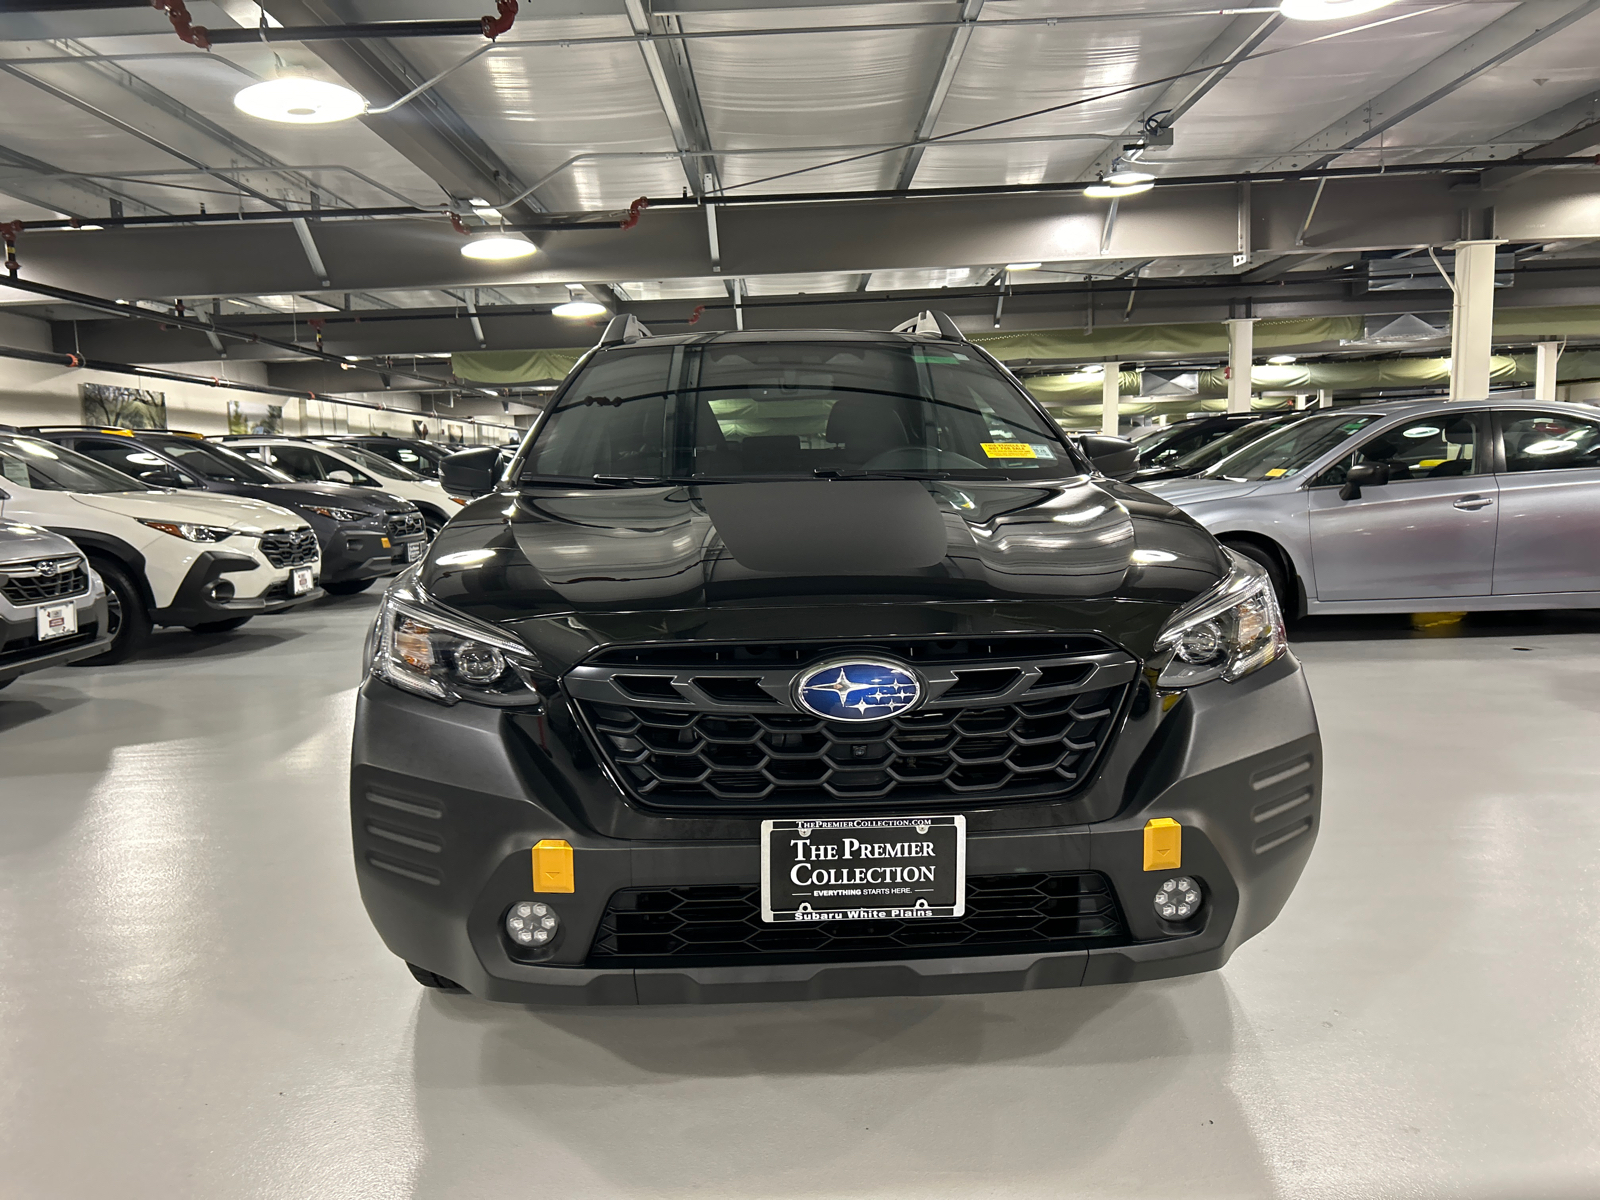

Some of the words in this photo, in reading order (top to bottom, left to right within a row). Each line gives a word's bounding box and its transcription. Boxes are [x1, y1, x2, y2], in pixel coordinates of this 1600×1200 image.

[790, 839, 839, 861] THE
[842, 838, 936, 859] PREMIER
[790, 863, 936, 886] COLLECTION
[813, 889, 862, 897] EVERYTHING
[891, 887, 913, 895] HERE.
[794, 911, 843, 921] Subaru
[847, 909, 887, 919] White
[892, 908, 933, 918] Plains
